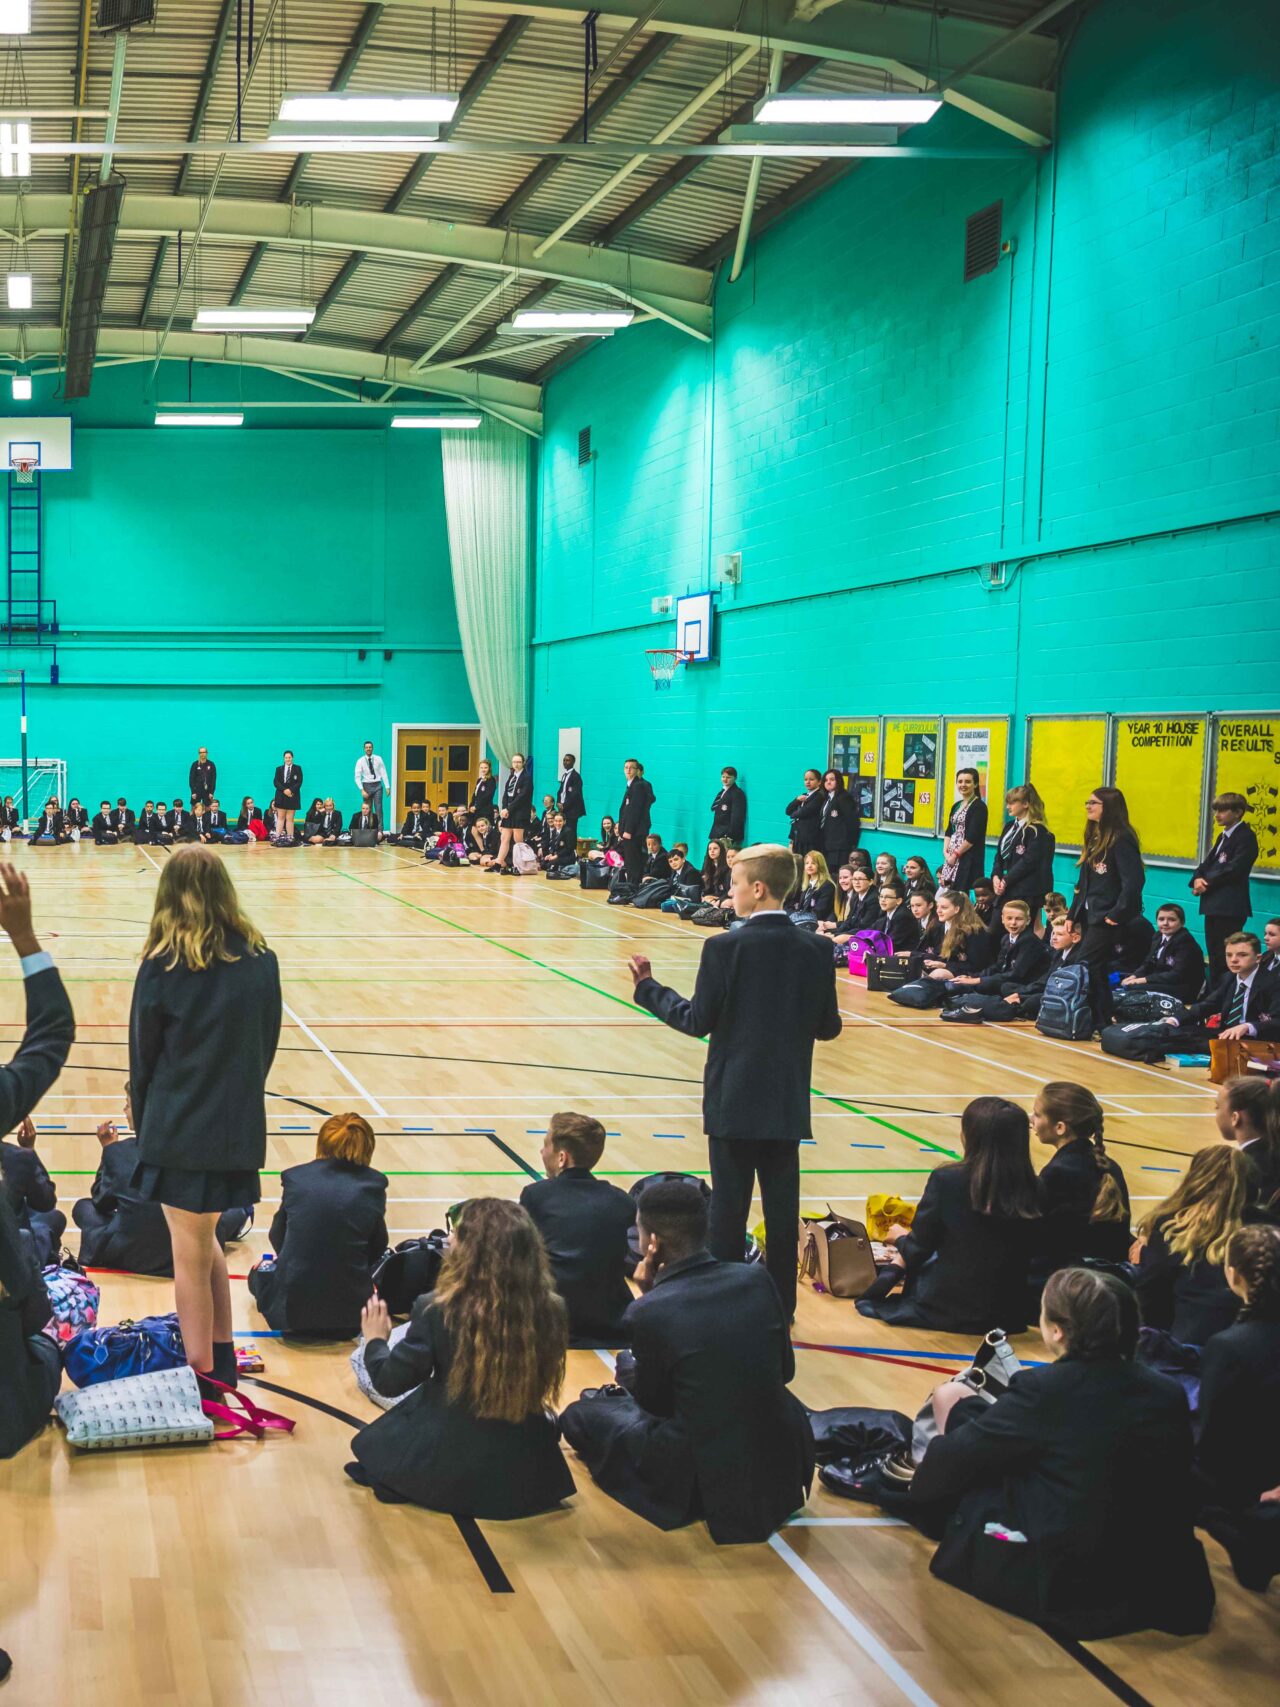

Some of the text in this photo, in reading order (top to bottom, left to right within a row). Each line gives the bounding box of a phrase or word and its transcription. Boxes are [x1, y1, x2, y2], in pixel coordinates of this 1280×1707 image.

[1127, 722, 1199, 734] YEAR 10 HOUSE
[1220, 724, 1274, 737] OVERALL
[1132, 736, 1193, 747] COMPETITION
[1221, 739, 1273, 752] RESULTS
[919, 793, 930, 804] KS3
